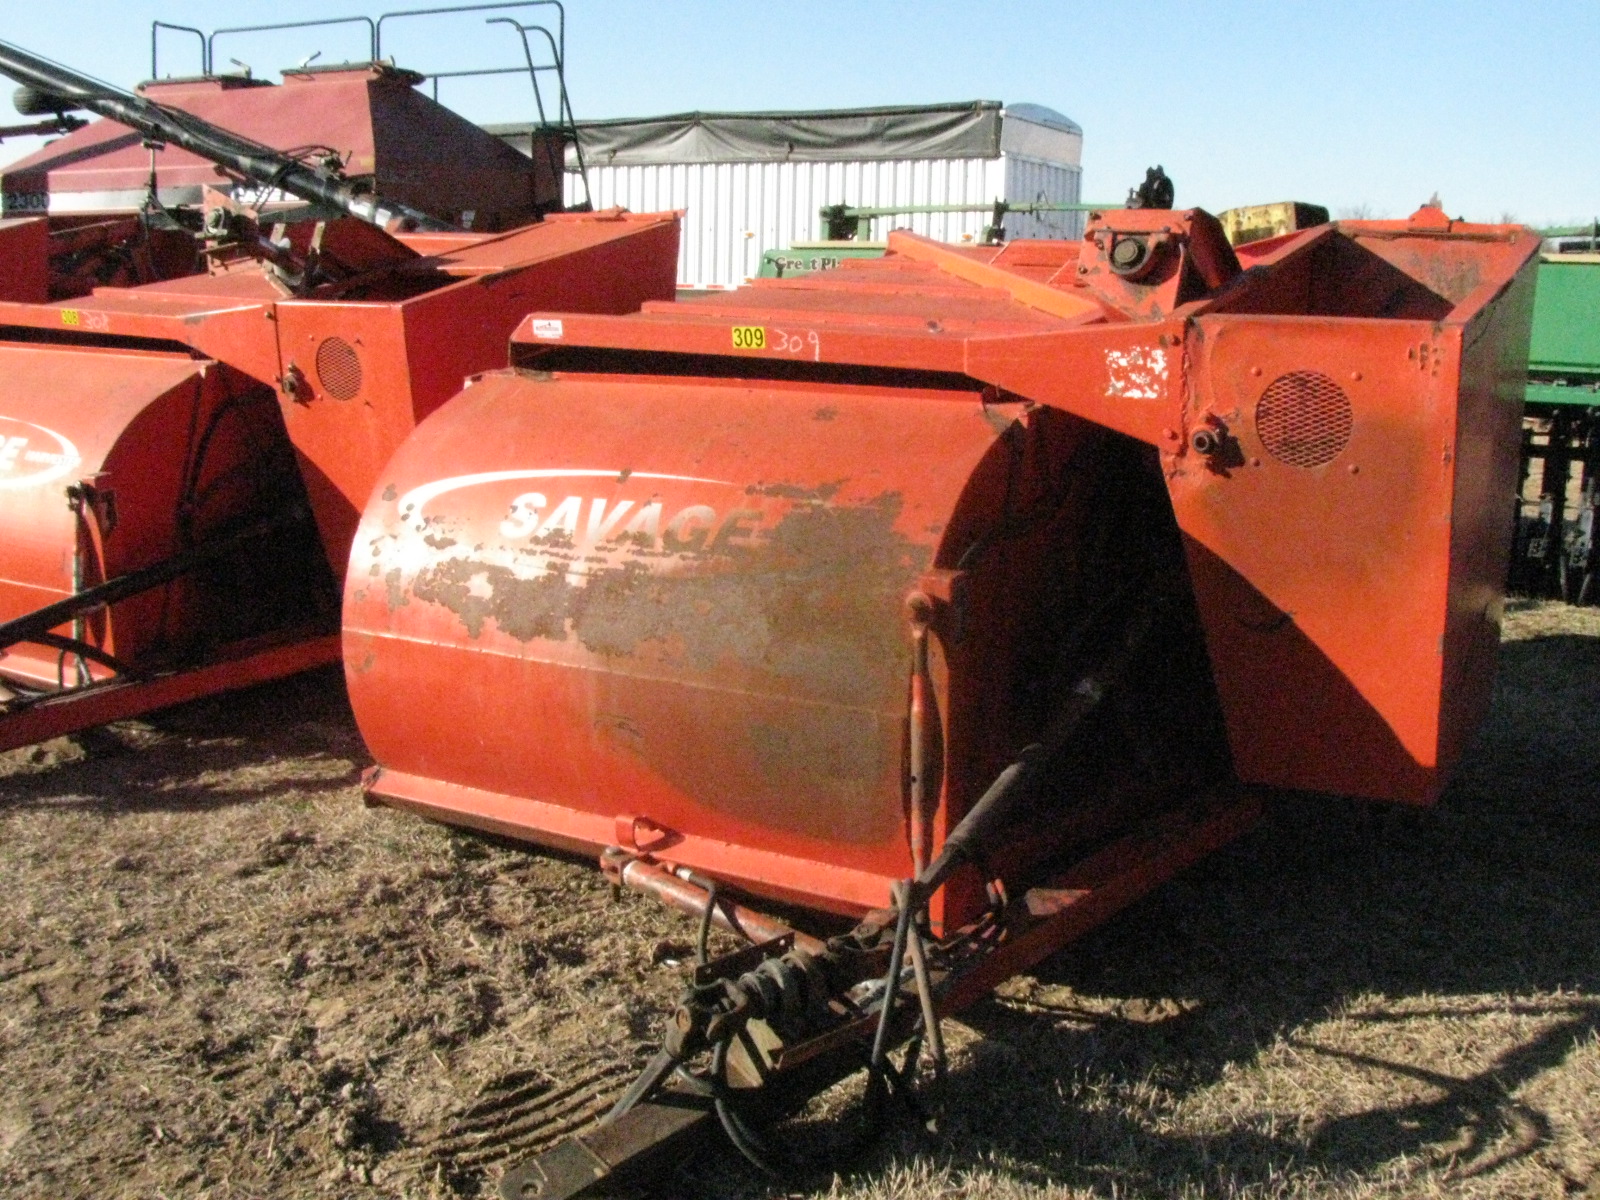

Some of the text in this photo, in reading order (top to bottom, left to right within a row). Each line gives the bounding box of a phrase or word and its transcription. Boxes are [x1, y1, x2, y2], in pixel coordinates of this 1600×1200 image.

[775, 256, 818, 270] Gret
[733, 327, 764, 347] 309
[772, 328, 819, 361] 309
[499, 491, 765, 552] SAVAGE
